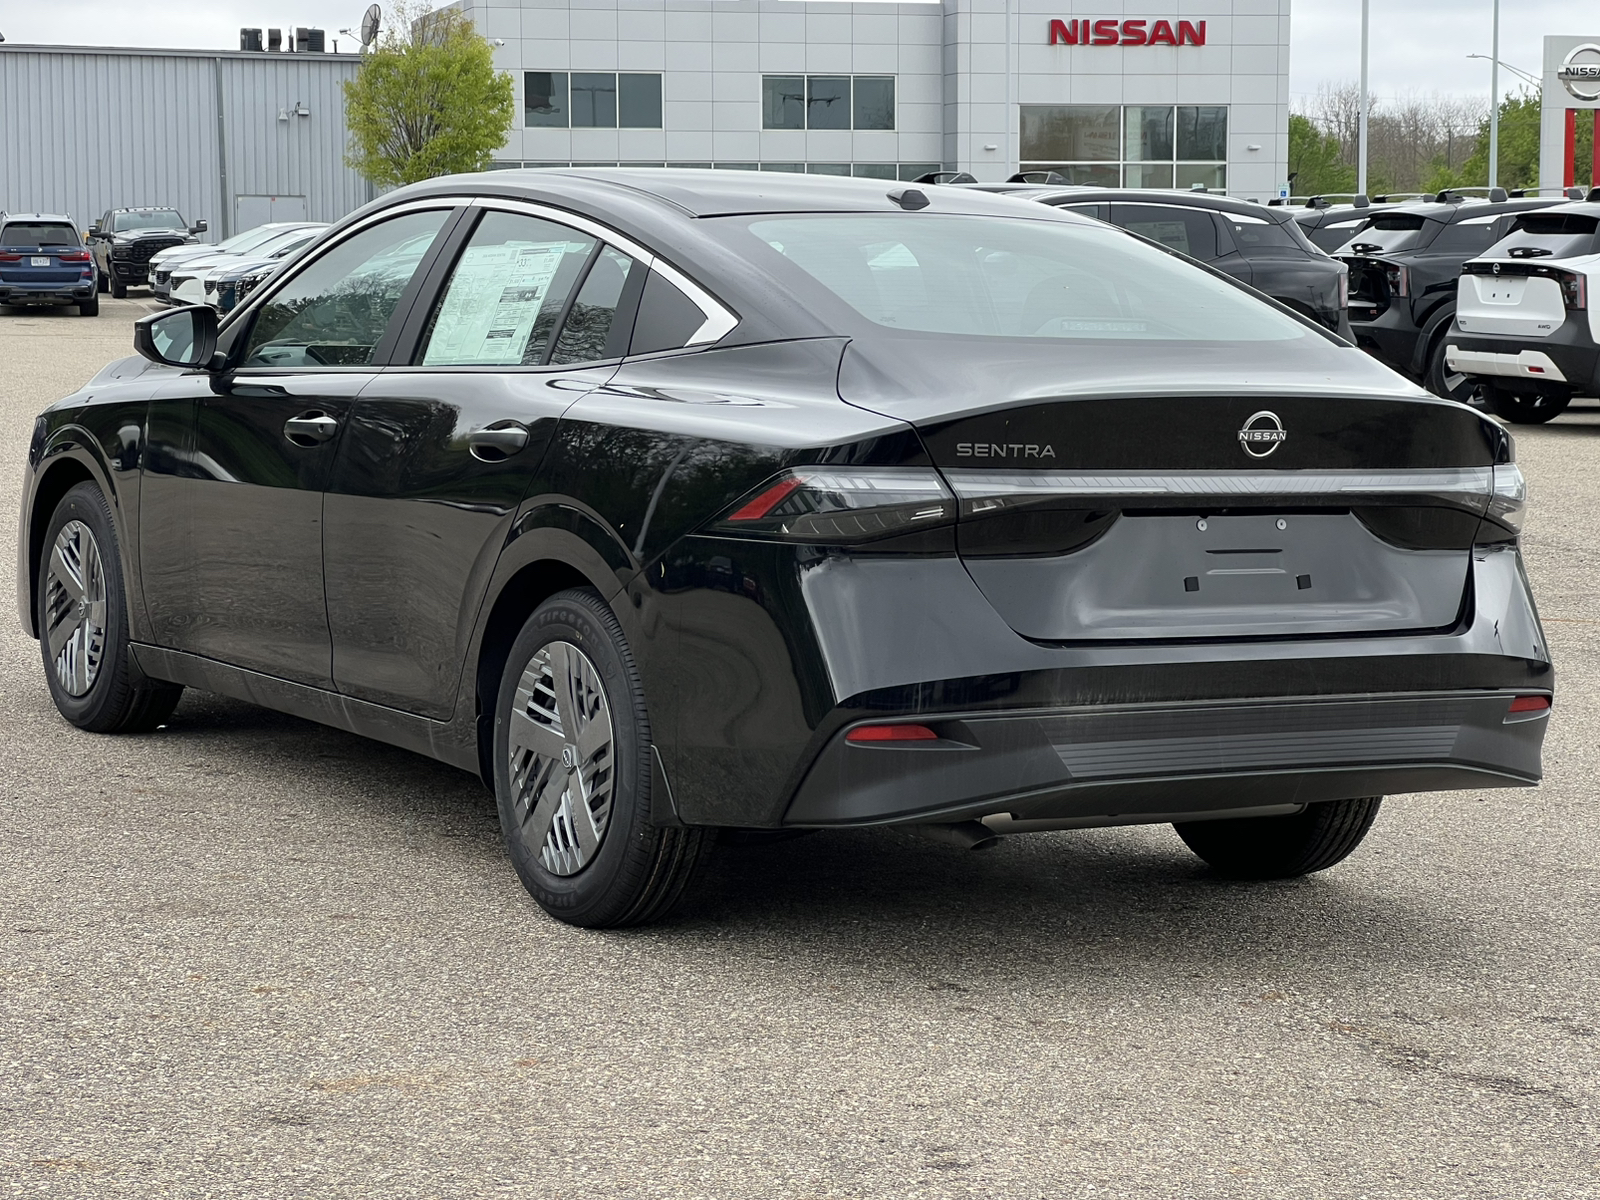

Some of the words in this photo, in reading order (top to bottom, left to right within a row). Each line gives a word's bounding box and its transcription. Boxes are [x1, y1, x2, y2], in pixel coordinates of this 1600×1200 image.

[1050, 19, 1206, 45] NISSAN
[1239, 432, 1286, 441] NISSAN
[956, 442, 1056, 458] SENTRA
